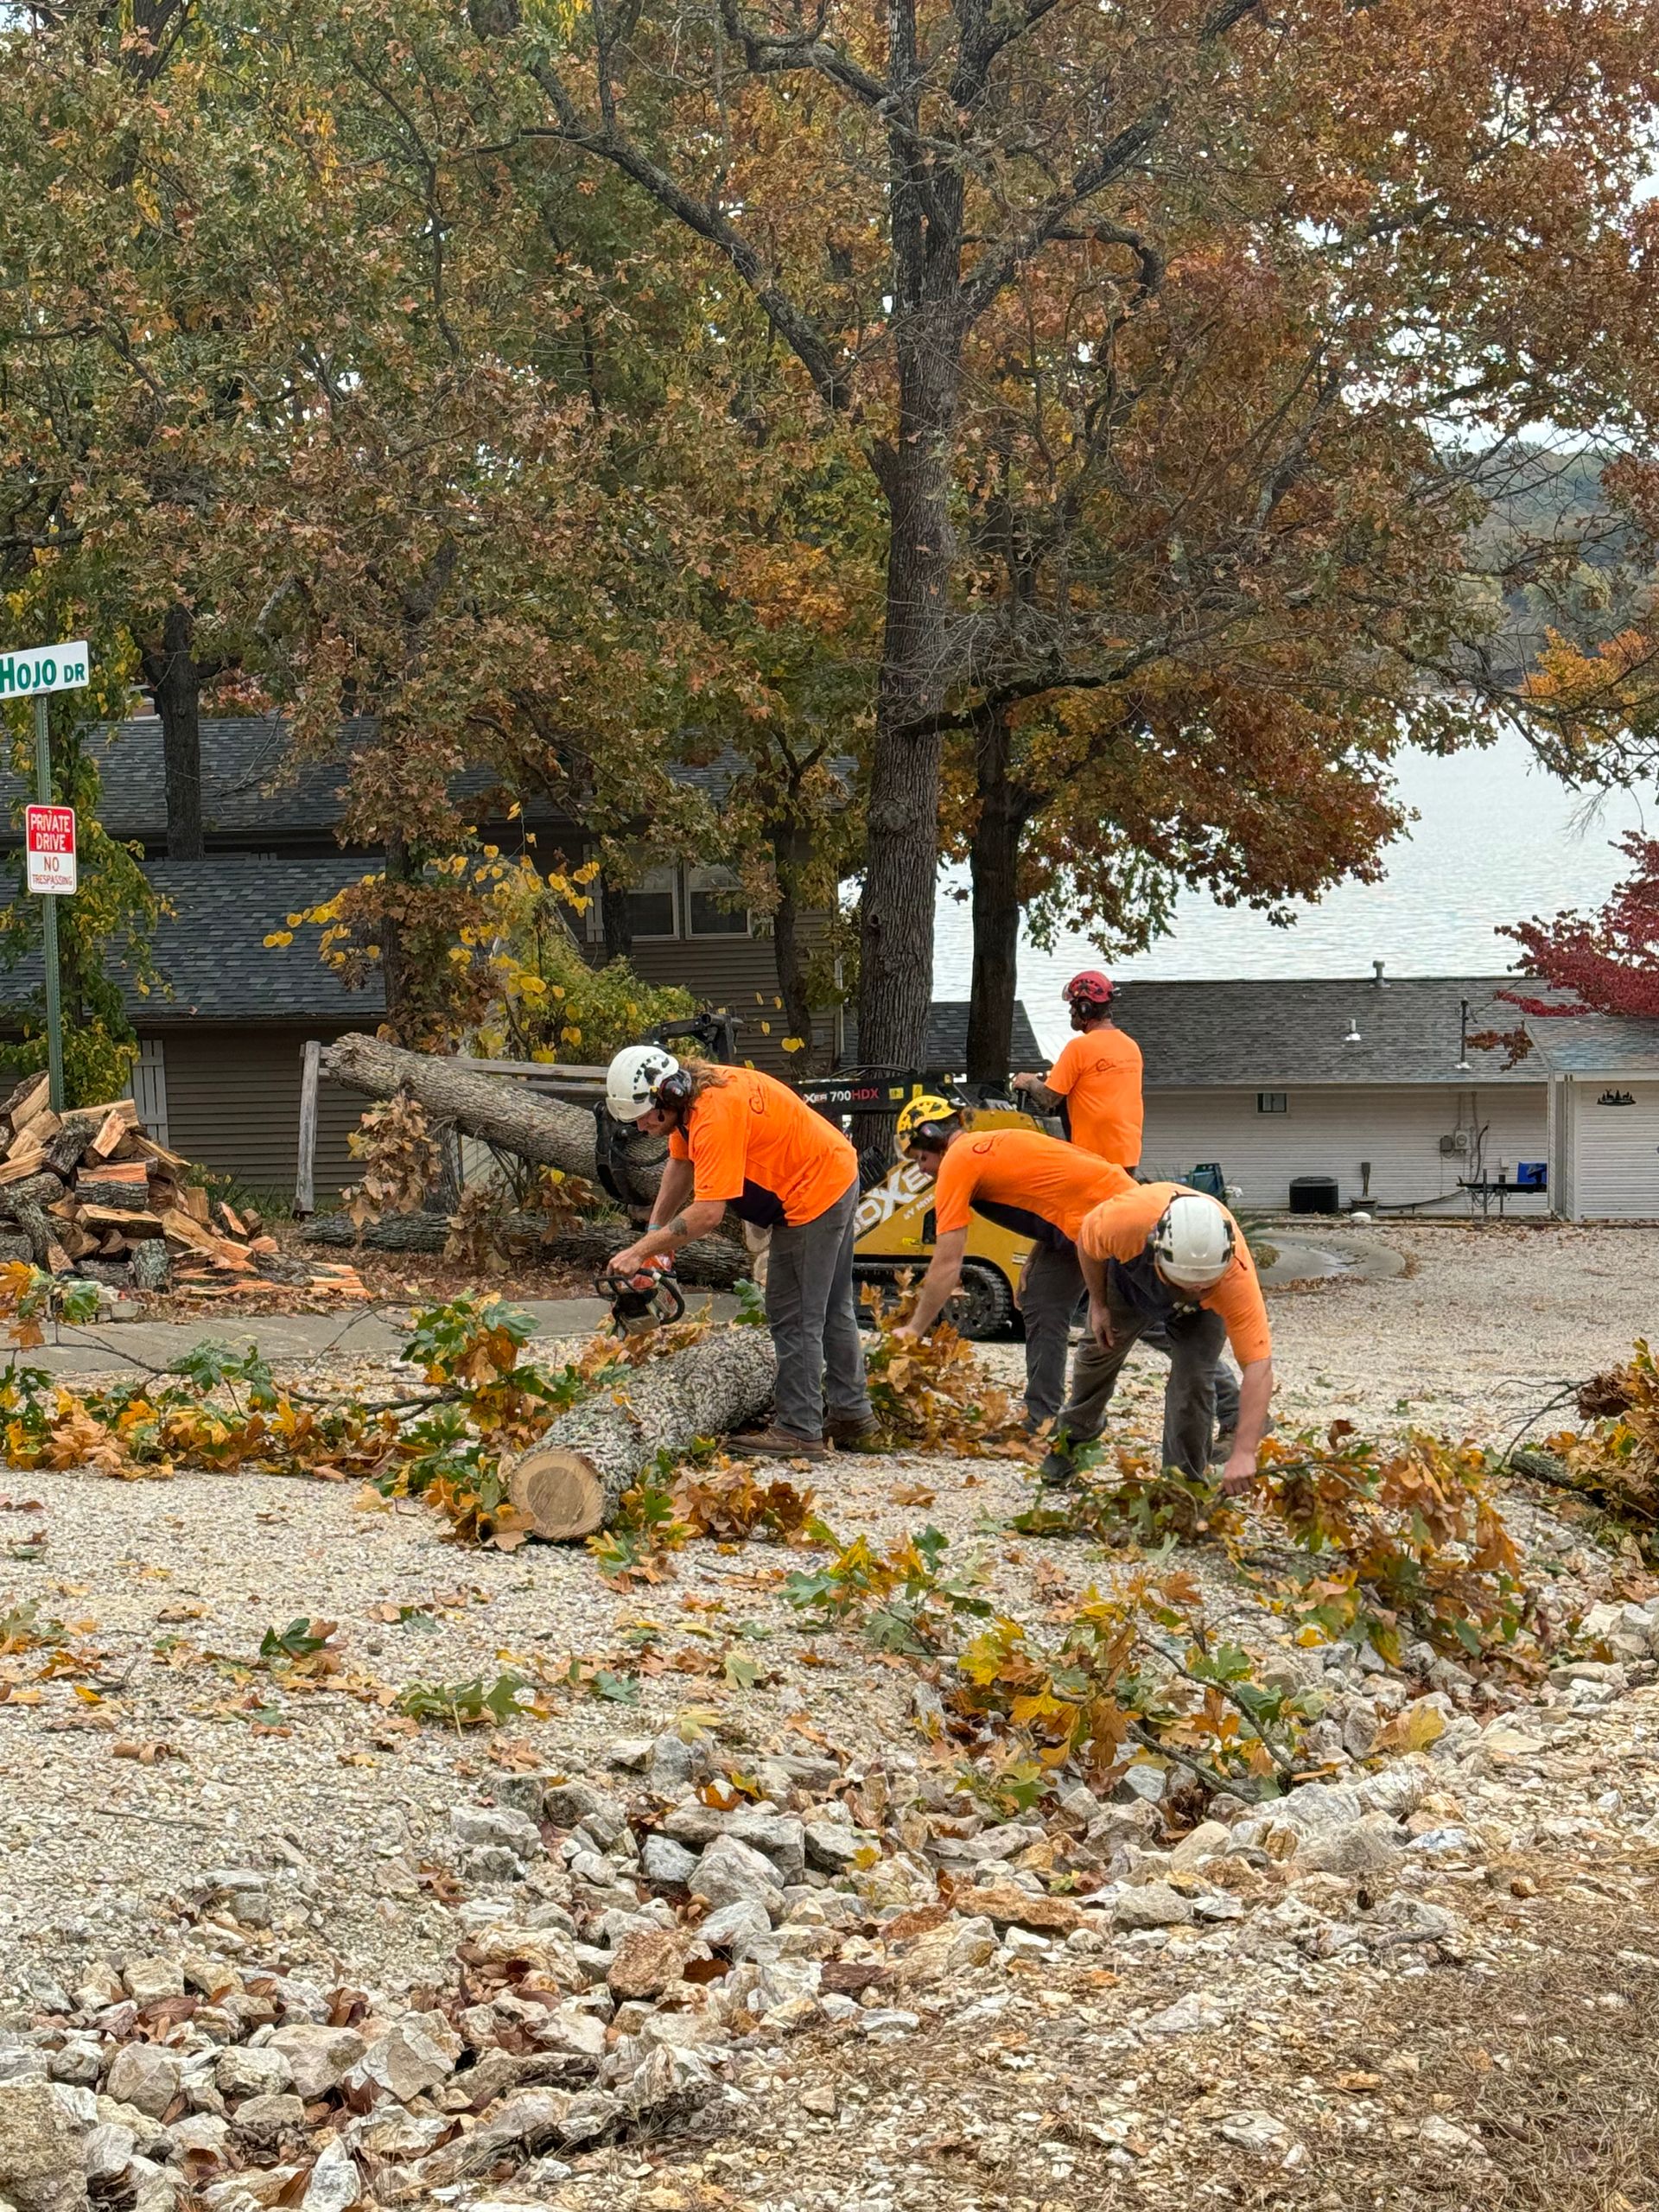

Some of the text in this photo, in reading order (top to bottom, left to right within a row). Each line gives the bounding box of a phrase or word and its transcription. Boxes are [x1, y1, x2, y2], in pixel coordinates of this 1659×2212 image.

[0, 657, 85, 693] HOJO DR
[30, 813, 70, 833] PRIVATE
[35, 833, 66, 851] DRIVE
[44, 856, 60, 872] NO
[803, 1092, 828, 1103] XER
[830, 1088, 879, 1103] 700HDX
[854, 1162, 934, 1236] OXE
